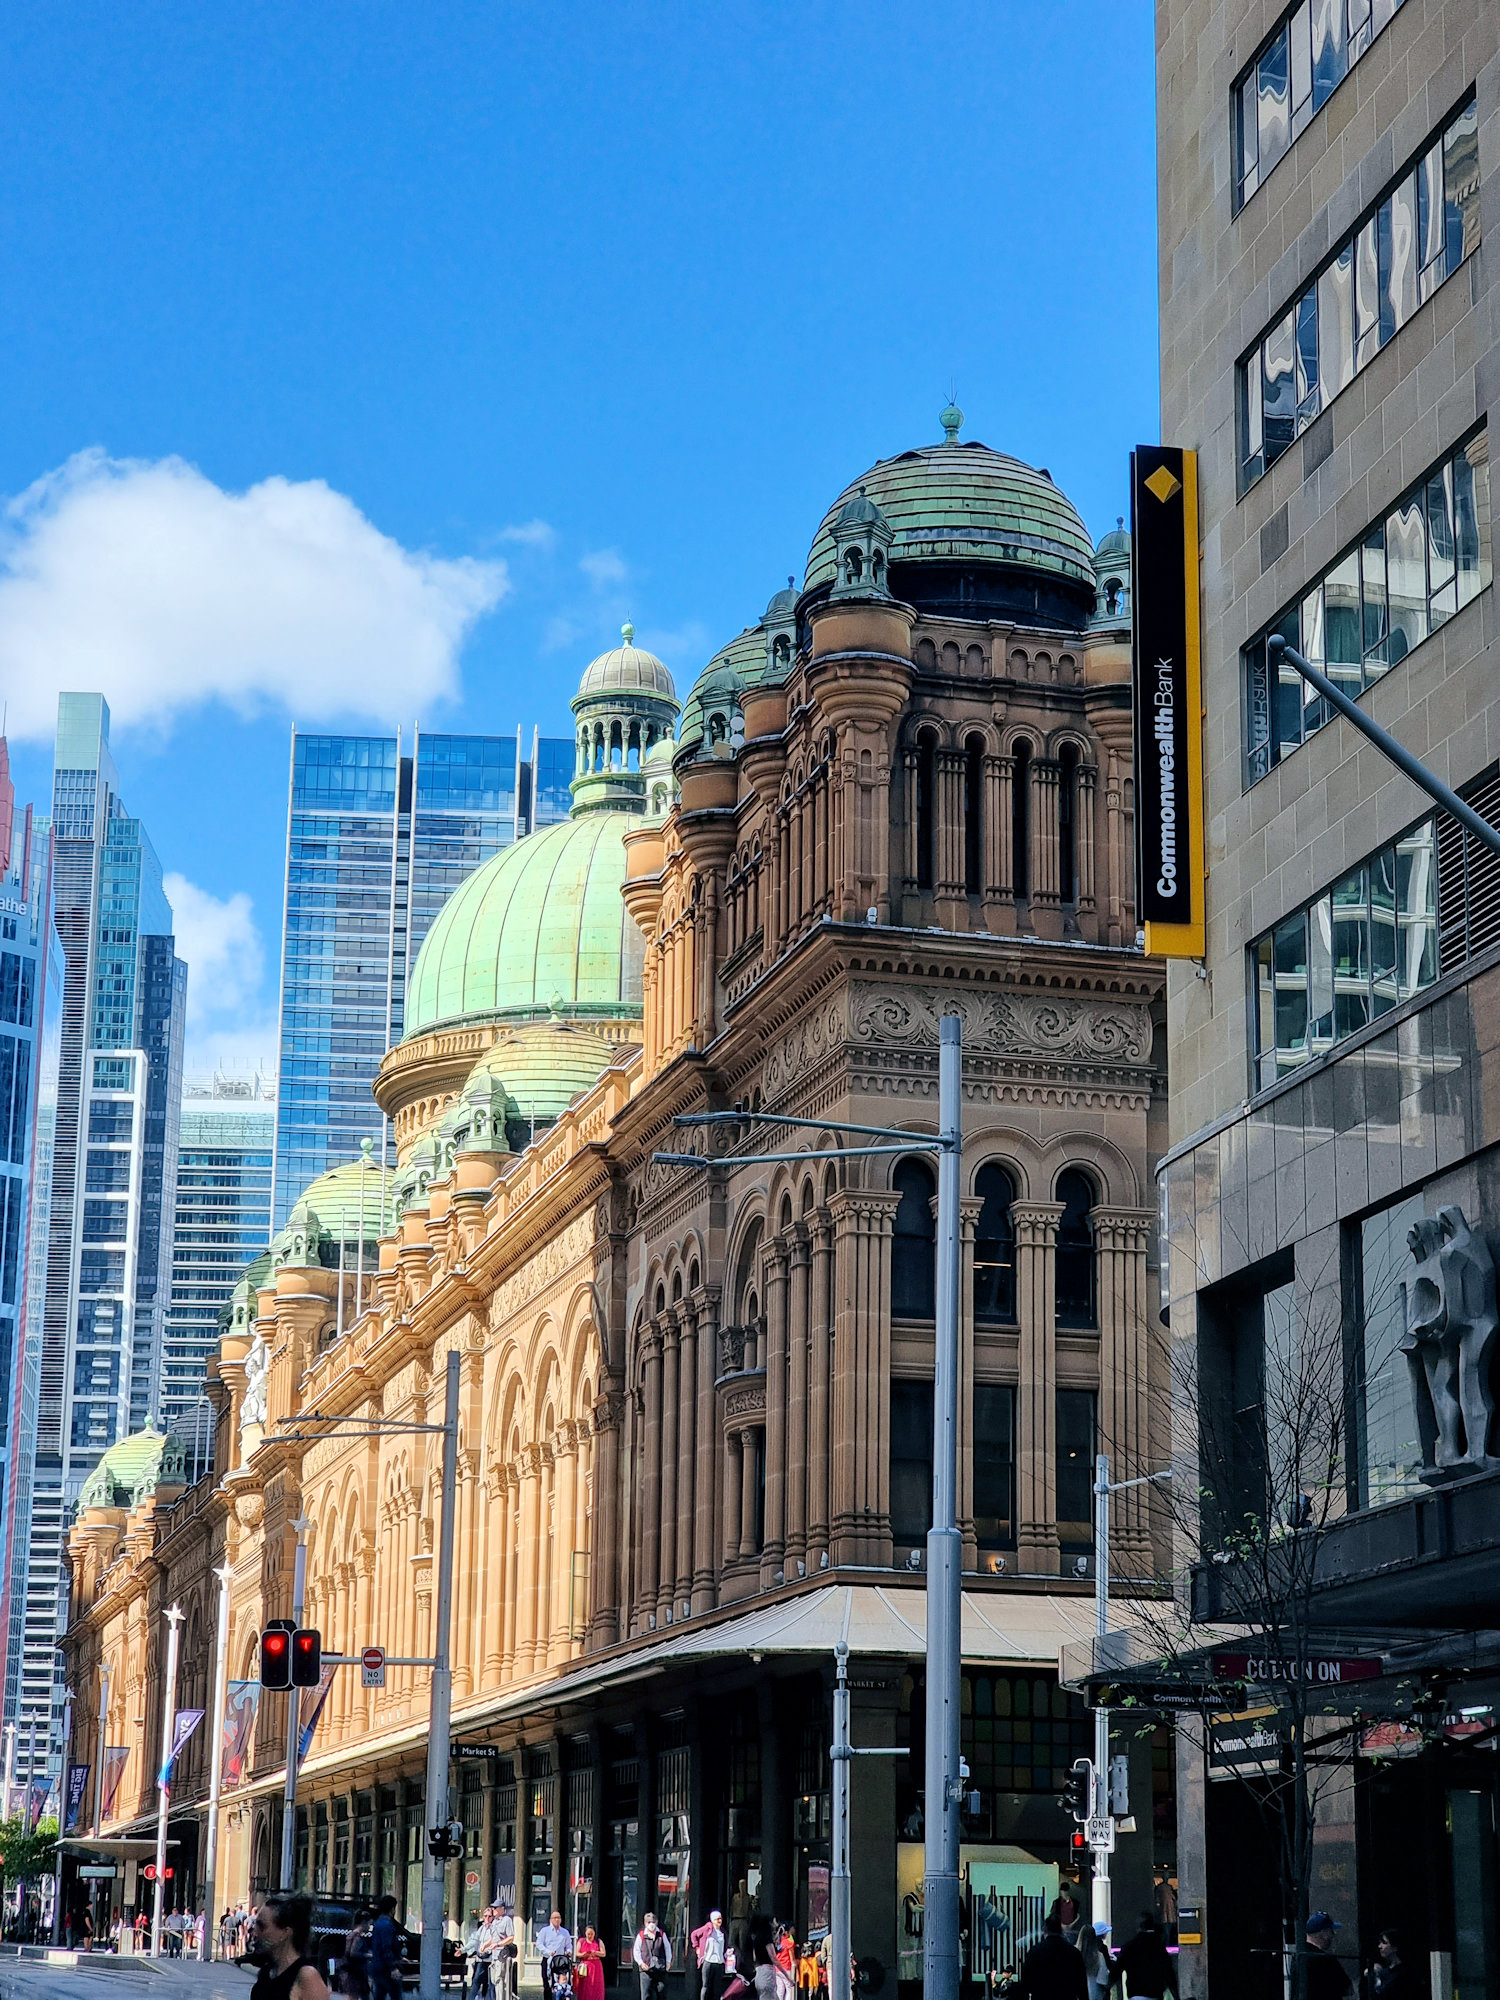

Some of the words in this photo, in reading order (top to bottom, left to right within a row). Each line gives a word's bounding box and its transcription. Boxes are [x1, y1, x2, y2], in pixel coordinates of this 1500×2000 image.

[1154, 657, 1177, 898] CommonwealthBank
[1318, 1661, 1341, 1681] ON
[461, 1747, 487, 1756] Market
[488, 1747, 496, 1756] St
[1092, 1820, 1110, 1829] ONE
[1090, 1831, 1111, 1839] WAY
